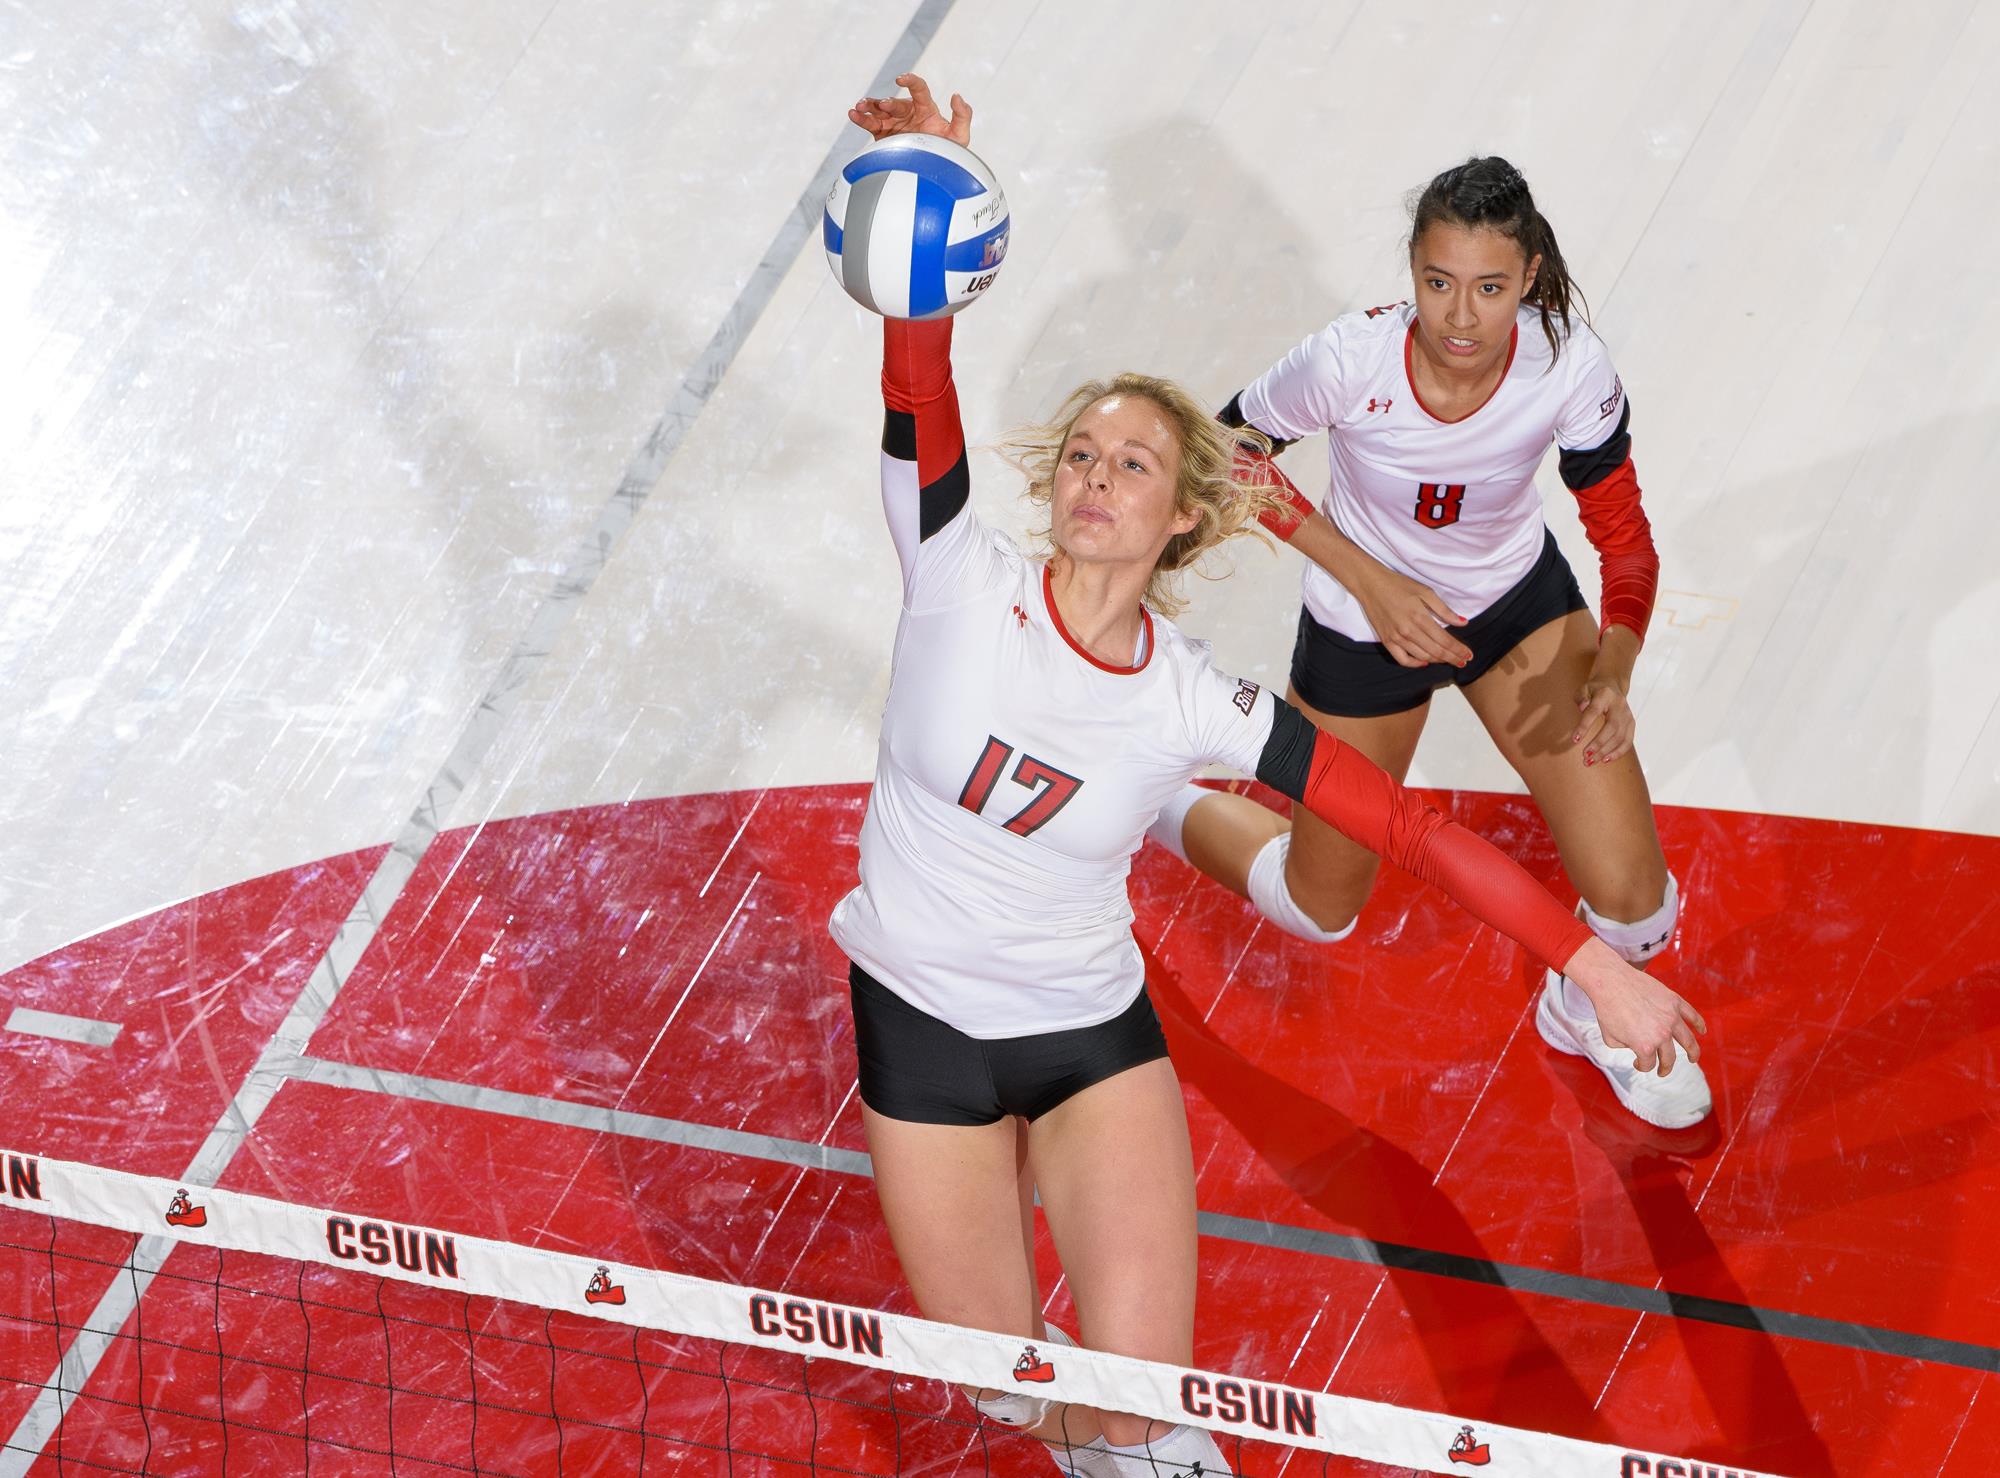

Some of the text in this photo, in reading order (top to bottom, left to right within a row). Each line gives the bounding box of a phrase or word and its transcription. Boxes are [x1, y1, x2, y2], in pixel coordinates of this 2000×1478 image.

[1413, 482, 1466, 530] 8
[957, 733, 1085, 838] 17
[0, 1153, 42, 1200] N
[326, 1216, 459, 1279] CSUN
[748, 1293, 885, 1358] CSUN
[1180, 1373, 1318, 1438] CSUN
